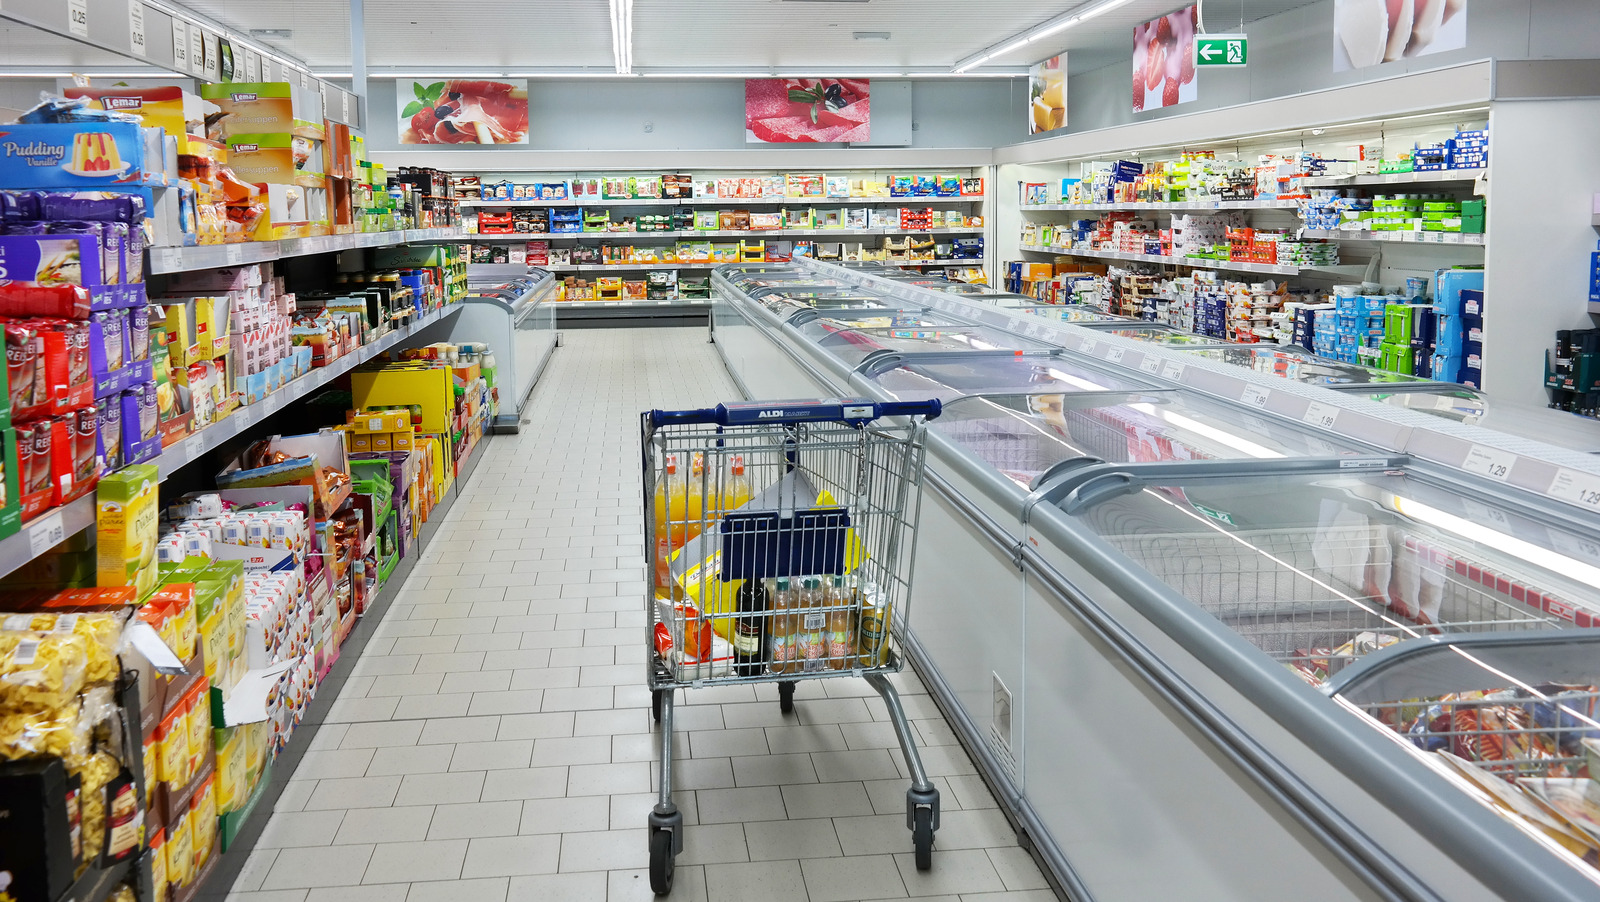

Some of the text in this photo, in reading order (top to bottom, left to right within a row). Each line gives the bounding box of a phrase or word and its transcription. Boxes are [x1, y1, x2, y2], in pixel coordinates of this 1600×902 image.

[72, 9, 86, 25] 0.25
[105, 97, 141, 109] Lemar
[234, 93, 257, 102] Lemar
[3, 141, 65, 160] Pudding
[235, 144, 258, 153] Lemar
[25, 157, 58, 167] Vanille
[1254, 395, 1267, 405] 1.99
[758, 410, 784, 419] ALDI
[1321, 415, 1334, 427] 1.99
[1488, 463, 1507, 477] 1.29
[1579, 489, 1600, 505] 1.29
